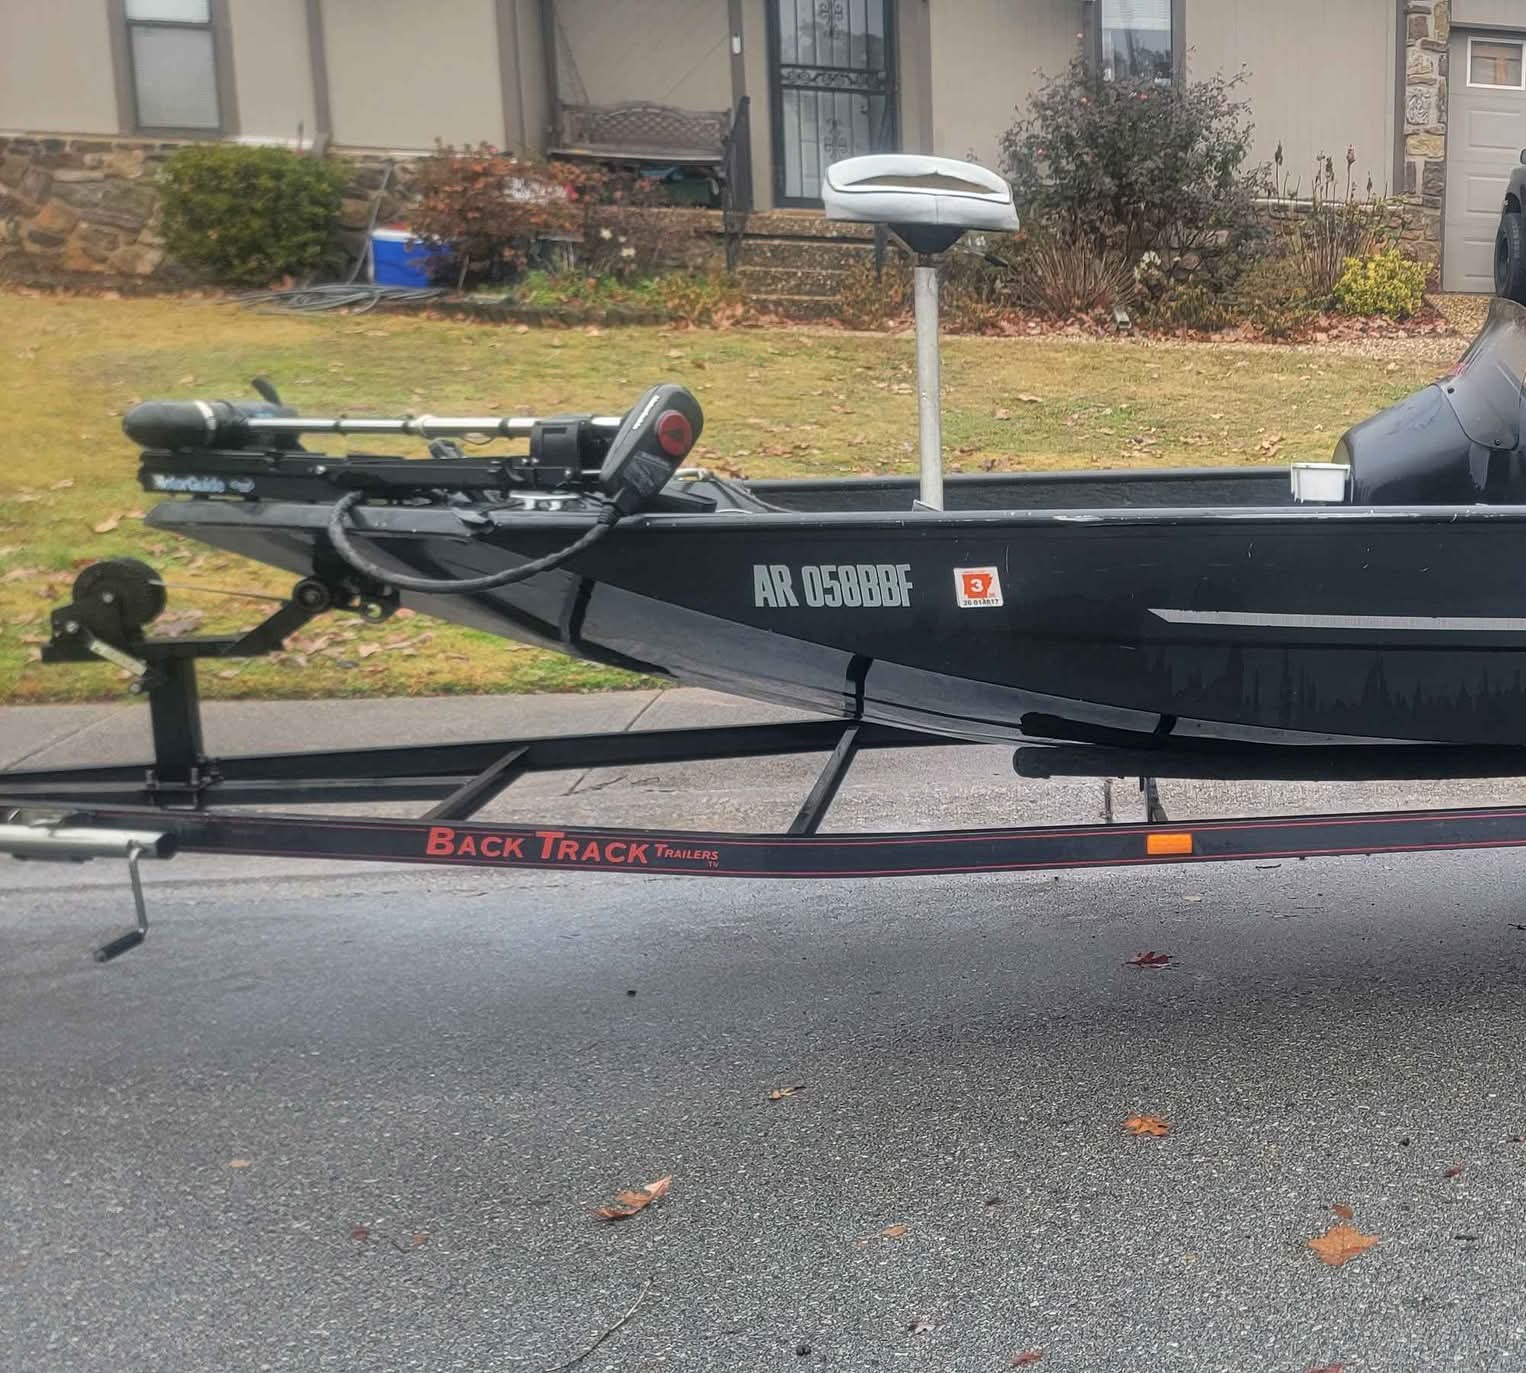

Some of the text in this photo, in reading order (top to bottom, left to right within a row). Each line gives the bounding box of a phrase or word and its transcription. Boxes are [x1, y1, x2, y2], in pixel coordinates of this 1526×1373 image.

[753, 564, 800, 608] AR
[970, 578, 984, 593] 3
[425, 826, 720, 864] BACK TRACK TRAILERS
